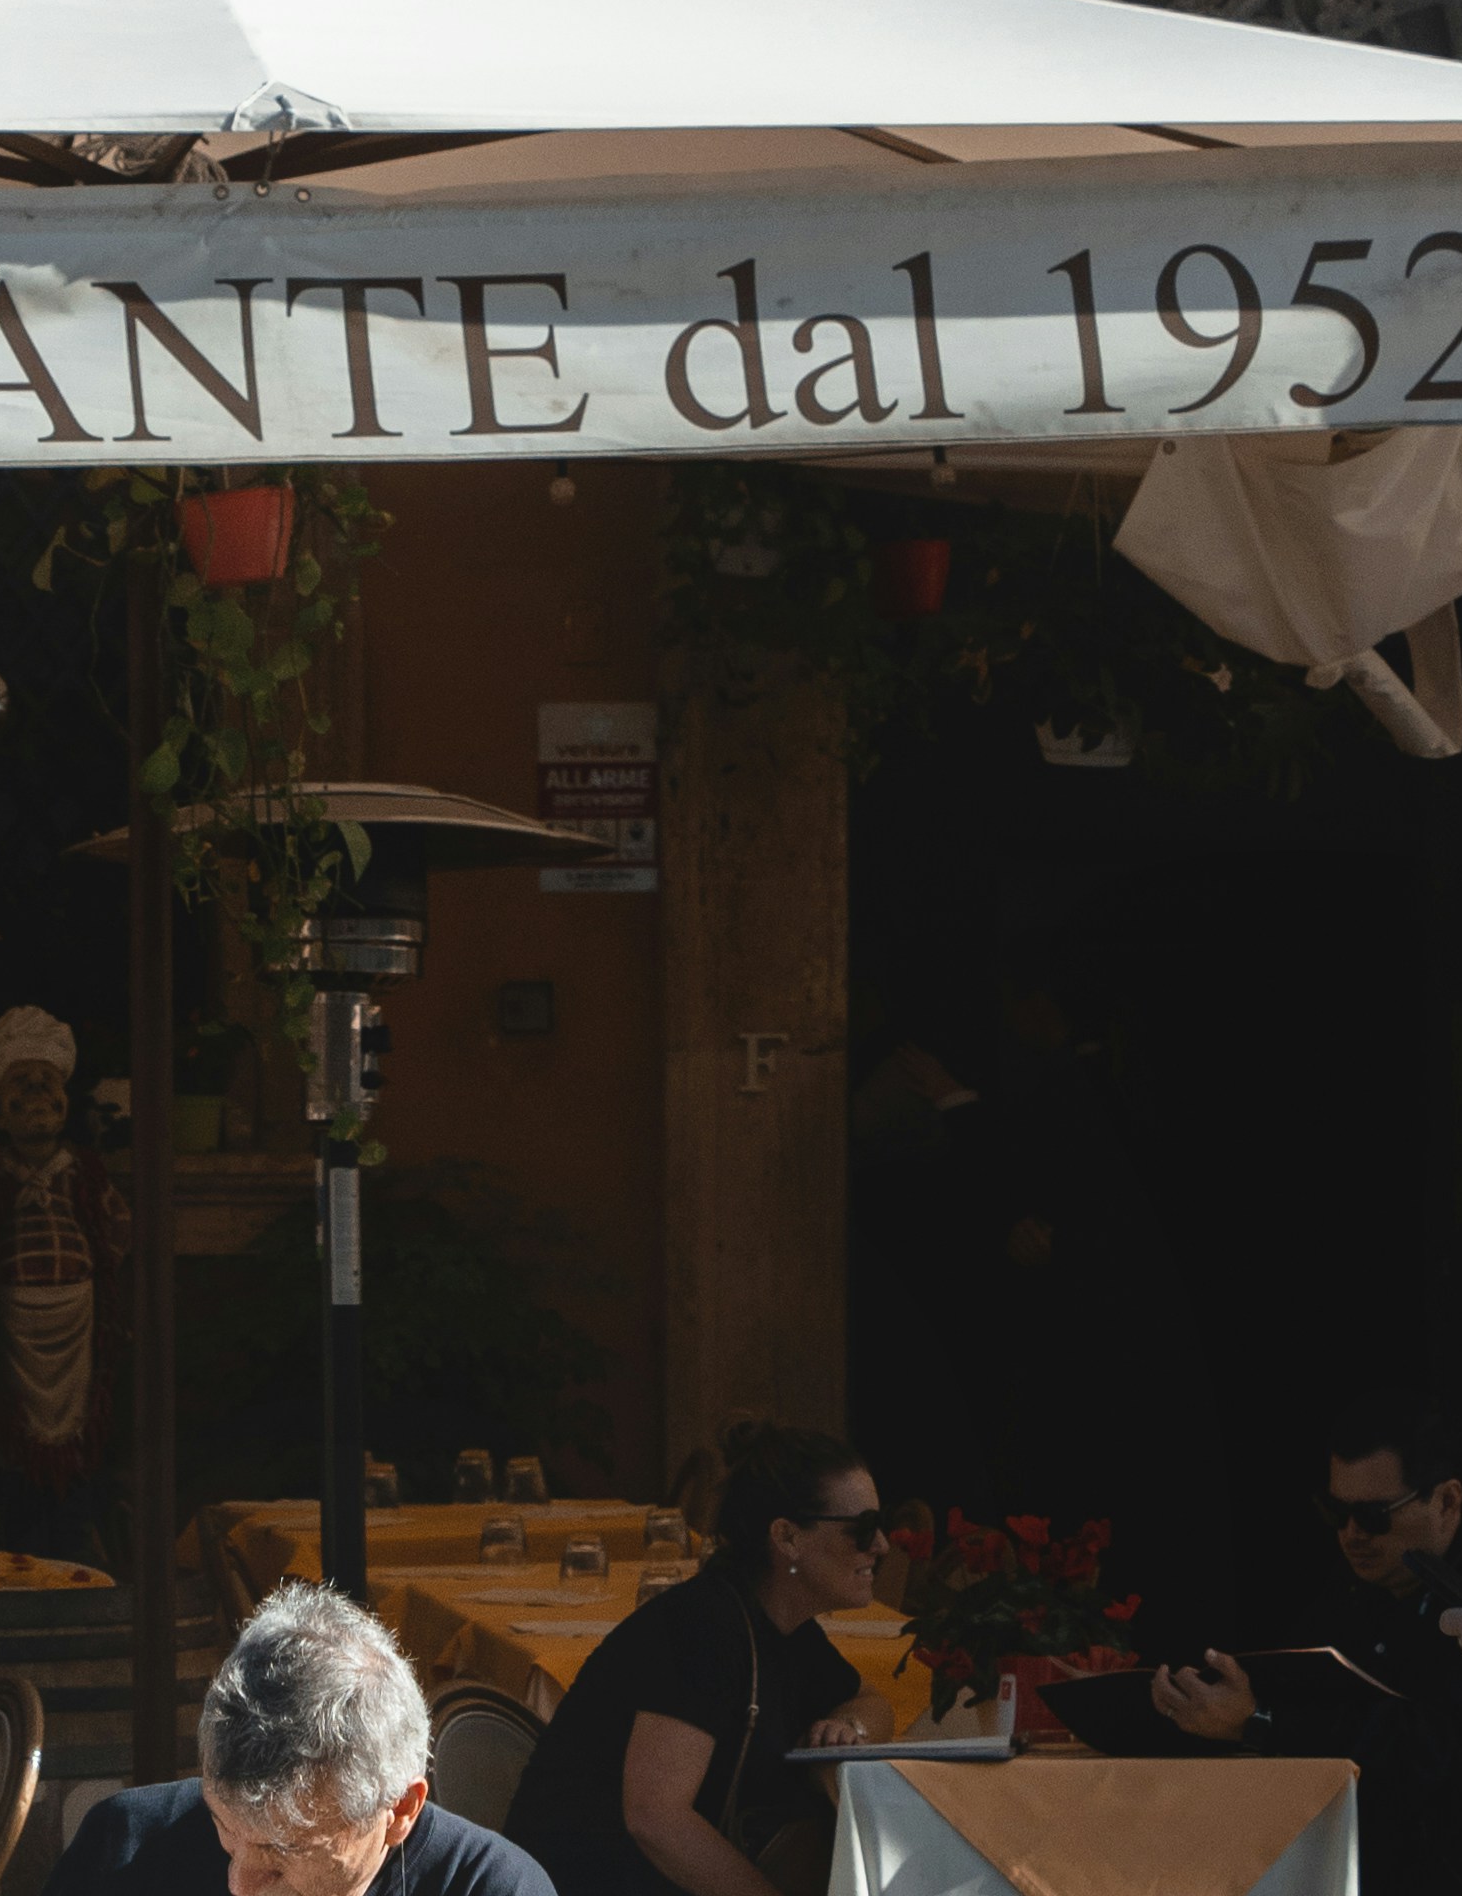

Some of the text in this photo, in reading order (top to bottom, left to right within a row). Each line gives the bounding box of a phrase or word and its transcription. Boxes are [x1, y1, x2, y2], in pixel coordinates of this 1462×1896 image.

[663, 249, 965, 433] dal
[546, 768, 651, 789] ALLARME
[738, 1032, 789, 1092] F
